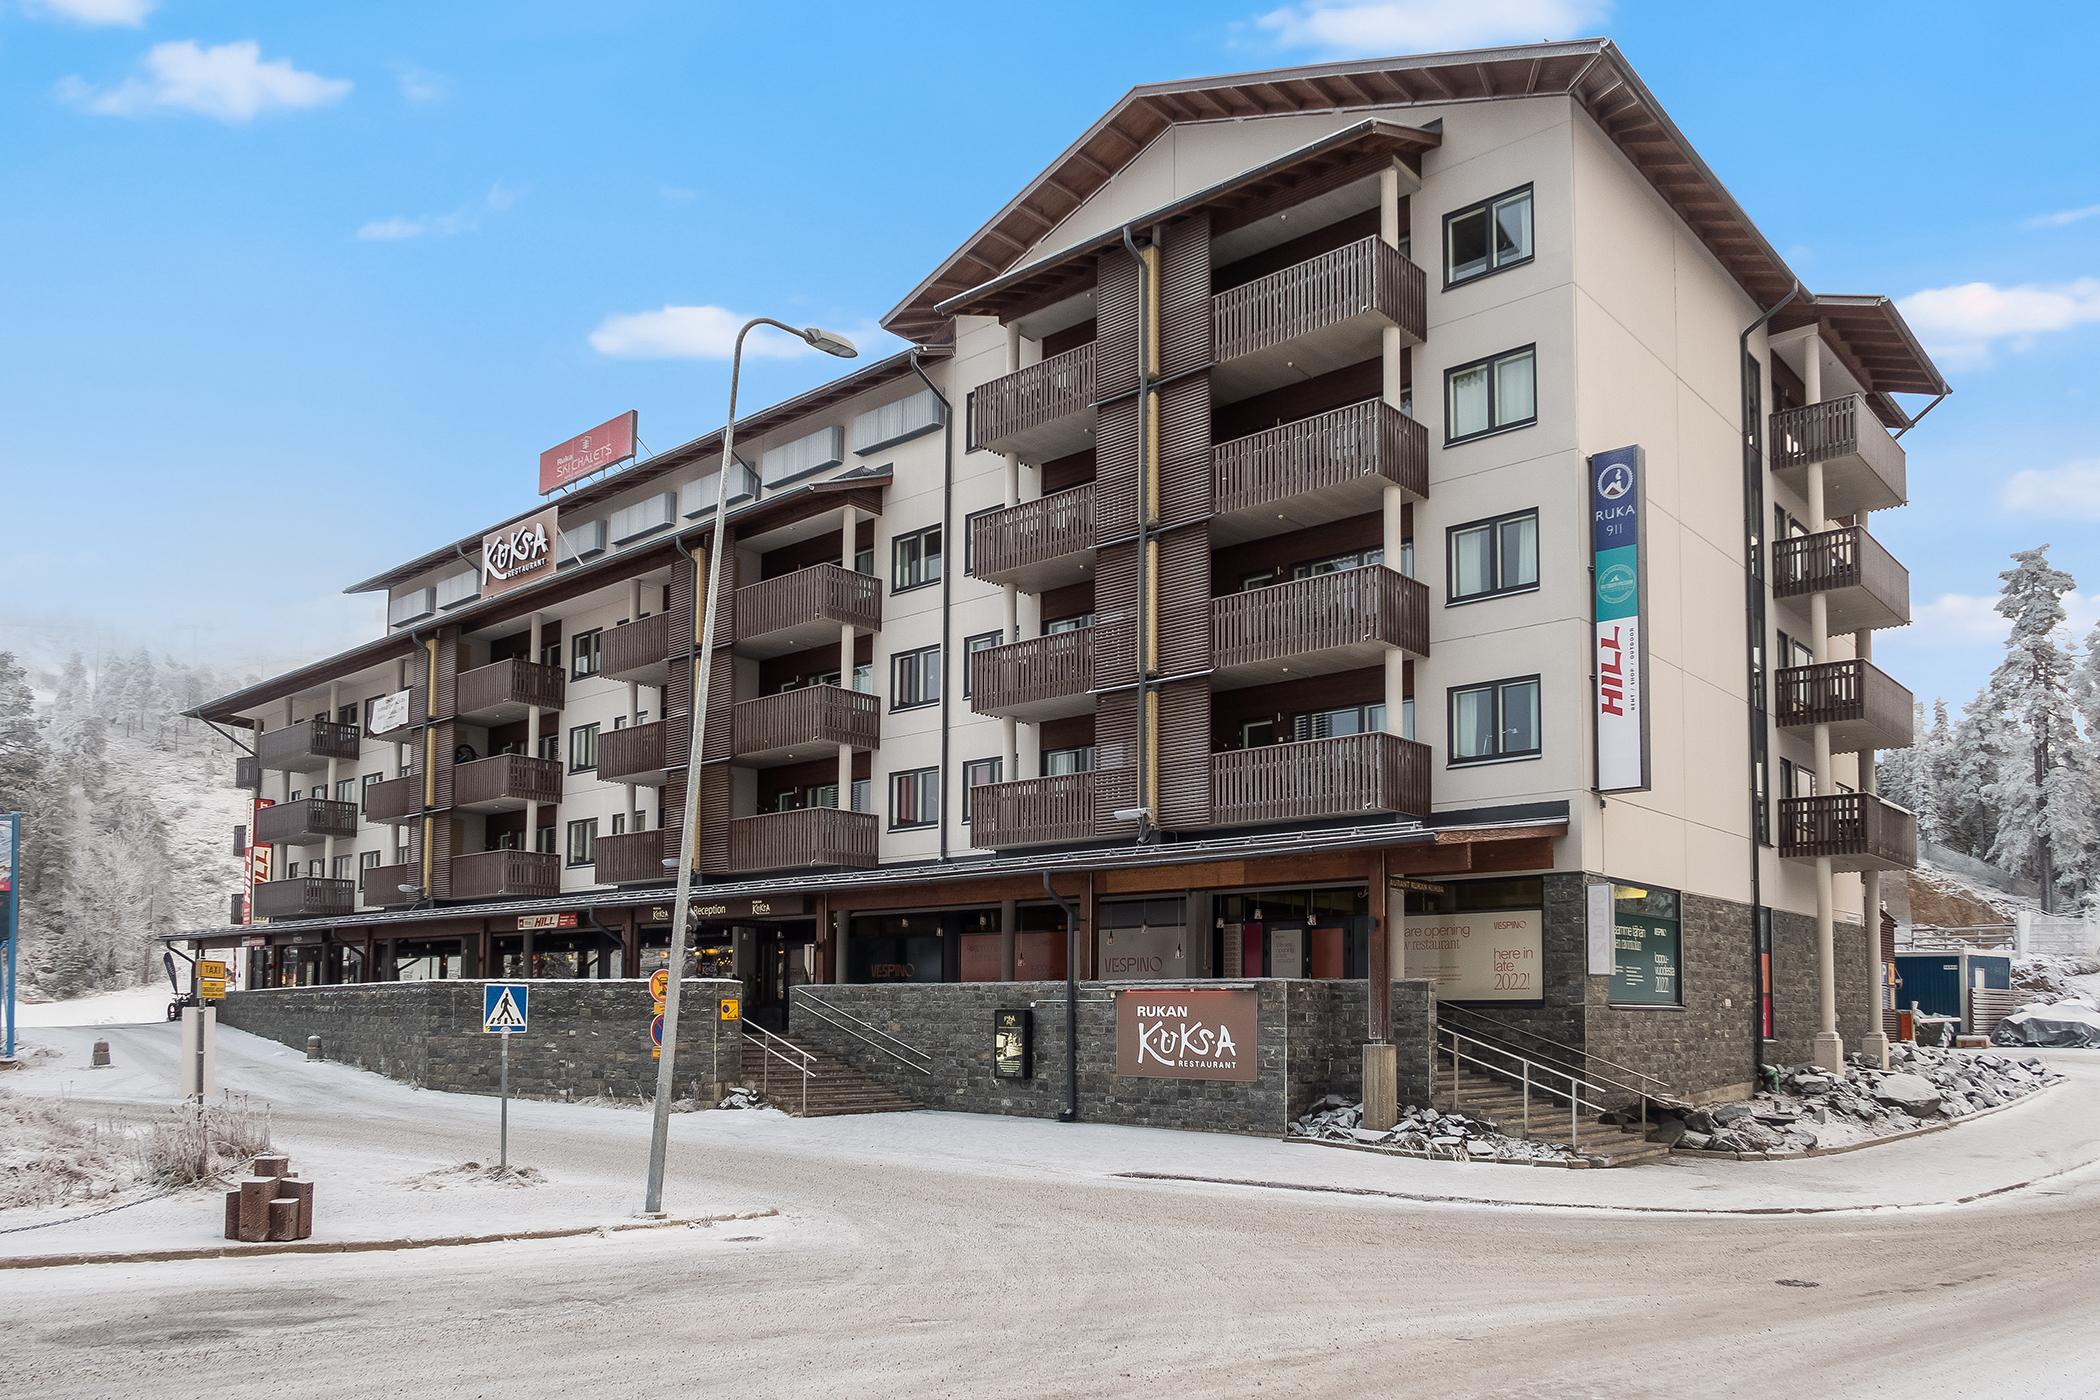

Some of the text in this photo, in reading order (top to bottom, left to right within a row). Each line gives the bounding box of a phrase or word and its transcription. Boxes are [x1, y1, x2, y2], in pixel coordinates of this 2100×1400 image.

[571, 444, 612, 471] CHALETS
[1595, 504, 1636, 522] RUKA
[1606, 523, 1623, 537] 911
[482, 523, 549, 585] KUKSA
[507, 557, 546, 578] RESTAURANT
[1601, 626, 1623, 717] HILL
[693, 904, 726, 917] Reception
[534, 916, 555, 928] HILL
[1493, 920, 1527, 930] VESPINO
[1404, 924, 1470, 938] are opening
[1412, 938, 1460, 951] restaurant
[1493, 947, 1534, 960] here in
[205, 965, 221, 974] TAXI
[871, 963, 915, 978] VESPINO
[1104, 956, 1163, 973] VESPINO
[1493, 960, 1515, 972] late
[1493, 973, 1531, 991] 2022!
[1137, 1005, 1188, 1018] RUKAN
[1137, 1020, 1236, 1067] KUKSA
[1178, 1060, 1237, 1069] RESTAURANT
